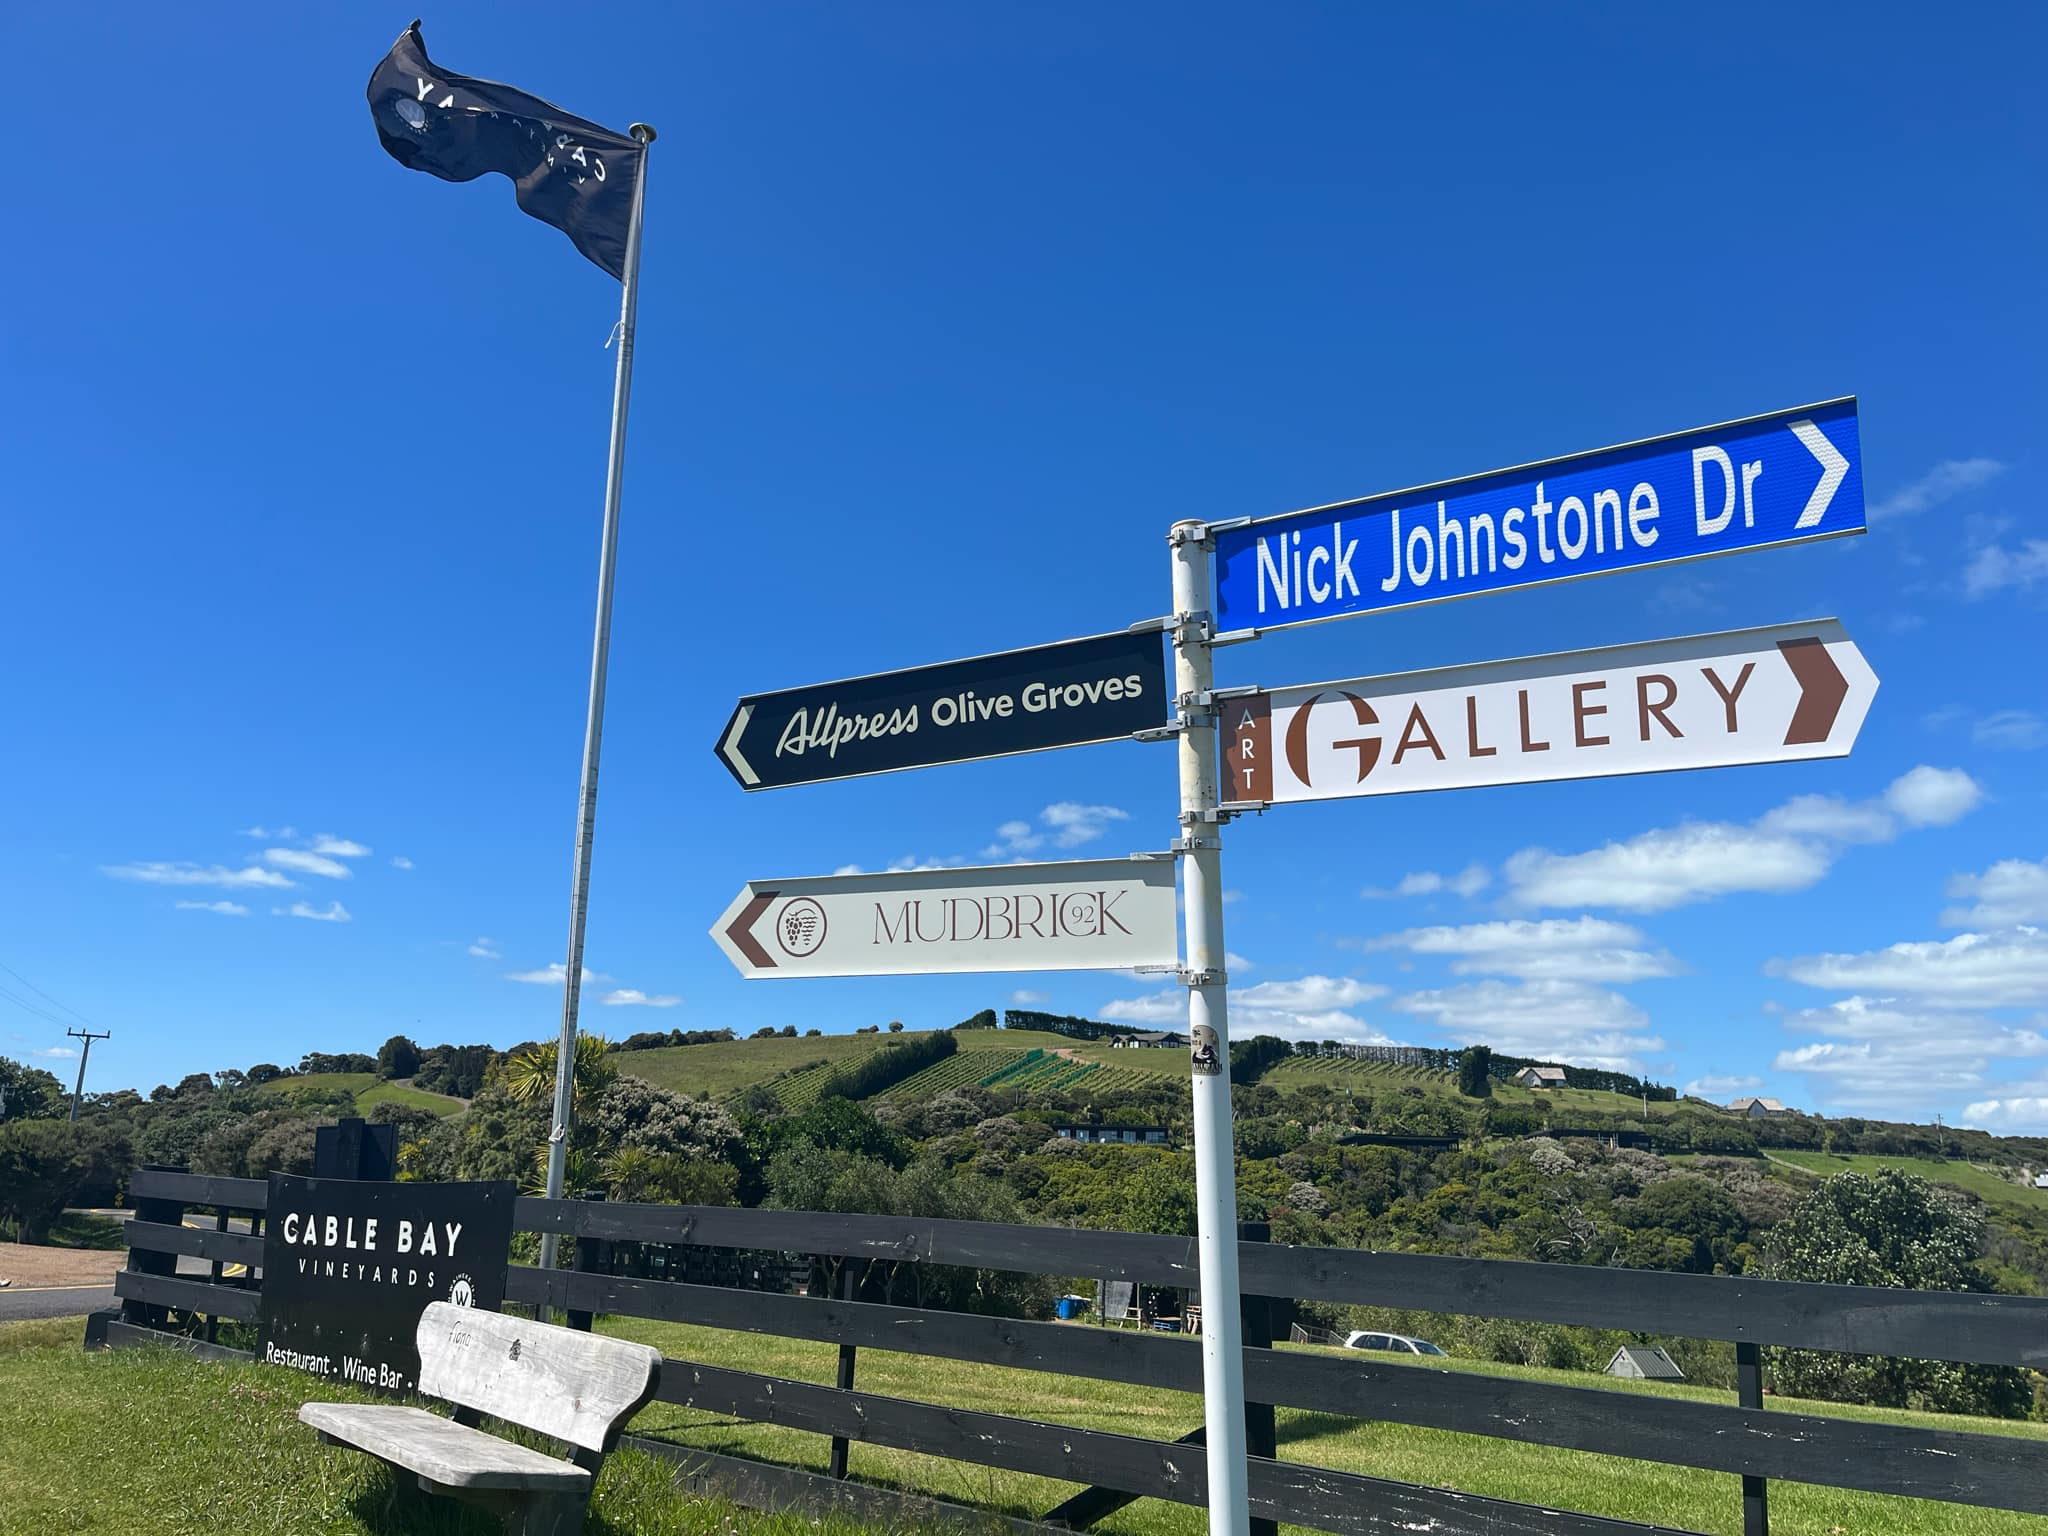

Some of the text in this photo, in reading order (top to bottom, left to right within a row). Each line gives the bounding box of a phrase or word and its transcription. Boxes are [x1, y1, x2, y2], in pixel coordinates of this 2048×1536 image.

[1256, 445, 1762, 613] Nick Johnstone Dr
[776, 674, 1143, 758] Allpress Olive Groves
[1238, 708, 1256, 789] ART
[1285, 663, 1756, 788] GALLERY
[872, 890, 1132, 945] MUDBRICK
[397, 1220, 462, 1257] BAY
[299, 1258, 435, 1288] VINEYARDS
[266, 1341, 403, 1389] Restaurant Wine Bar
